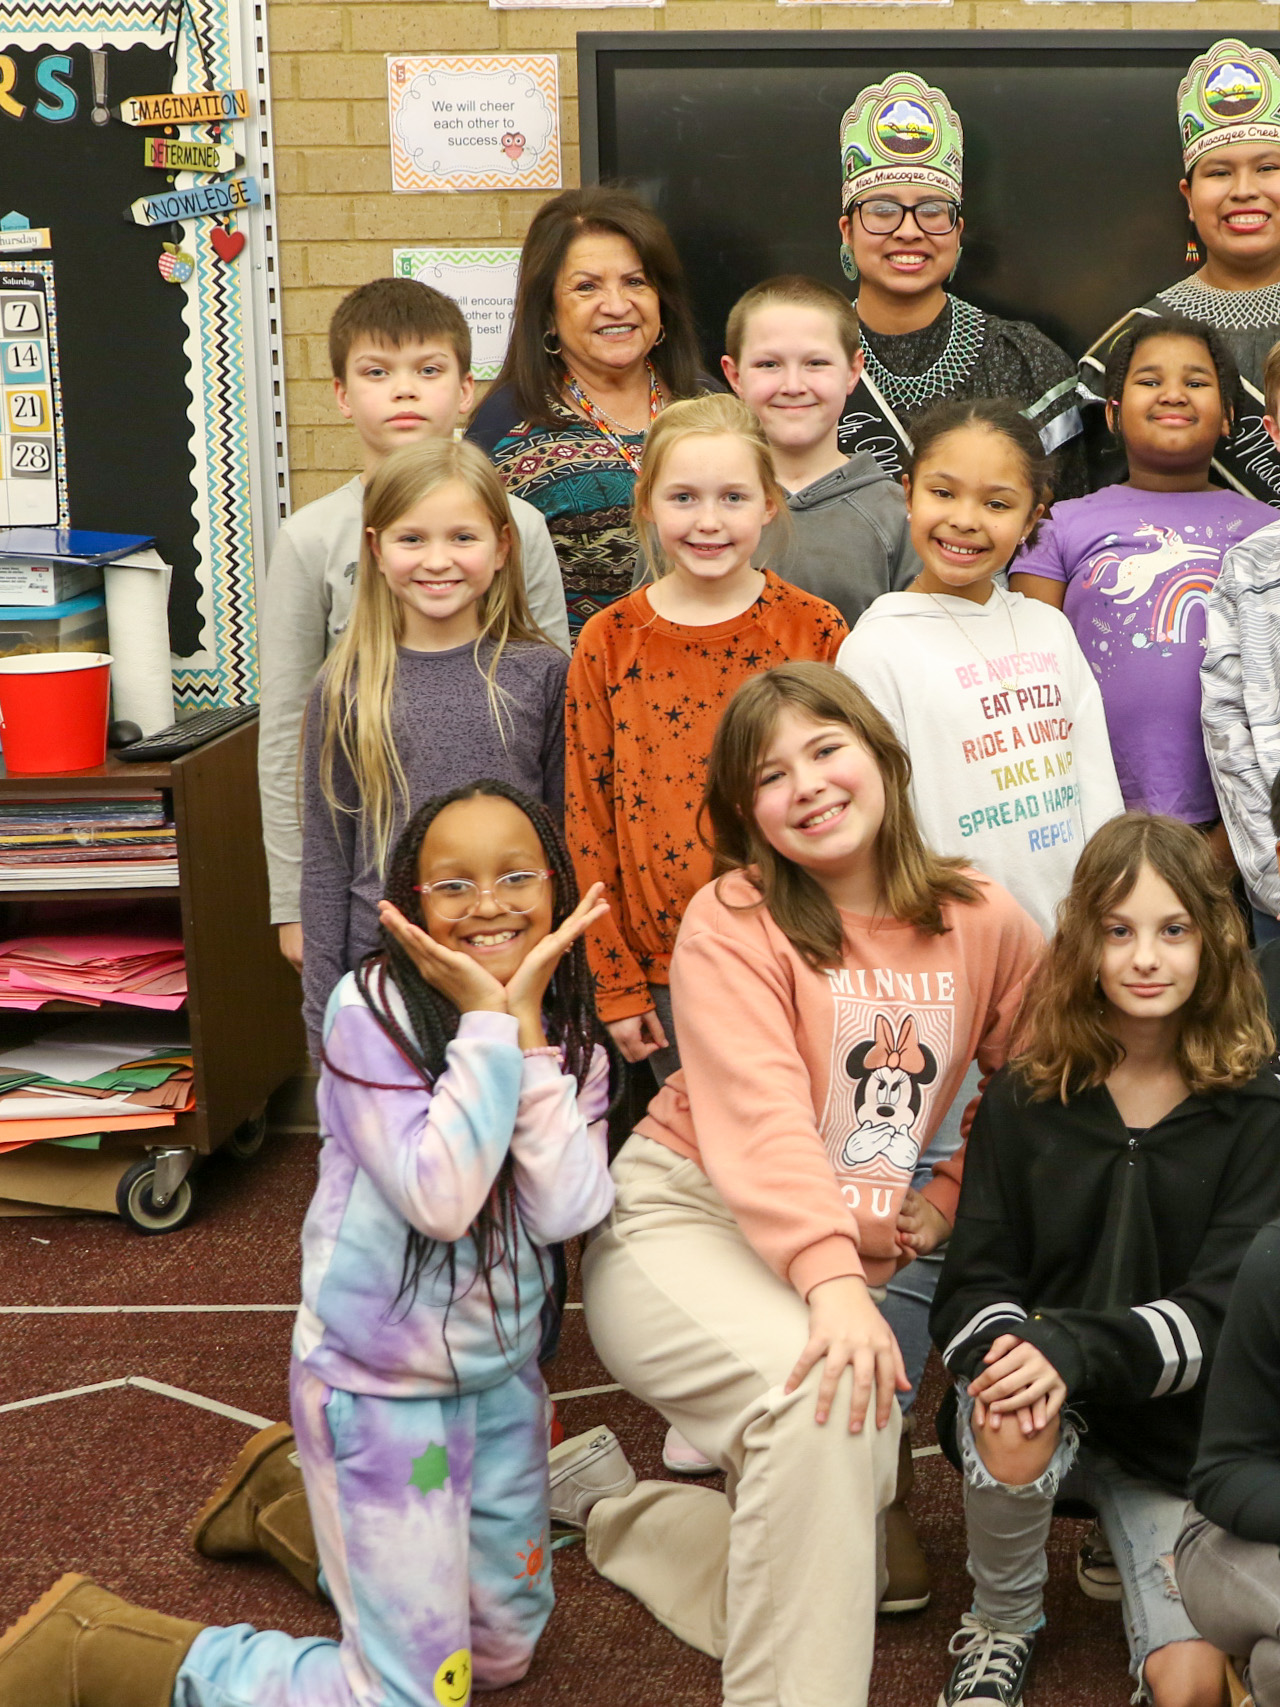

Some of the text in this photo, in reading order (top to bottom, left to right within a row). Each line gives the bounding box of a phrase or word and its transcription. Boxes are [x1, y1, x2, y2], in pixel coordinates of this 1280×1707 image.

[129, 93, 247, 122] IMAGINATION
[432, 100, 515, 112] We will cheer
[433, 118, 515, 129] each other to
[150, 144, 221, 168] DETERMINED
[142, 180, 251, 223] KNOWLEDGE
[0, 234, 38, 247] hursday
[403, 261, 411, 272] 6
[2, 276, 35, 288] Saturday
[471, 296, 516, 307] encoura
[12, 304, 27, 328] 7
[466, 311, 491, 320] other
[495, 310, 505, 320] to
[477, 324, 502, 334] best!
[12, 344, 38, 368] 14
[14, 395, 38, 418] 21
[16, 444, 46, 469] 28
[955, 651, 1062, 690] BE AWESOME
[980, 684, 1062, 720] EAT PIZZA
[961, 717, 1073, 764] RIDE A UNICO
[991, 758, 1040, 791] TAKE
[1044, 755, 1055, 779] A
[958, 794, 1040, 838] SPREAD
[1027, 818, 1074, 853] REPEA
[825, 968, 955, 1001] MINNIE
